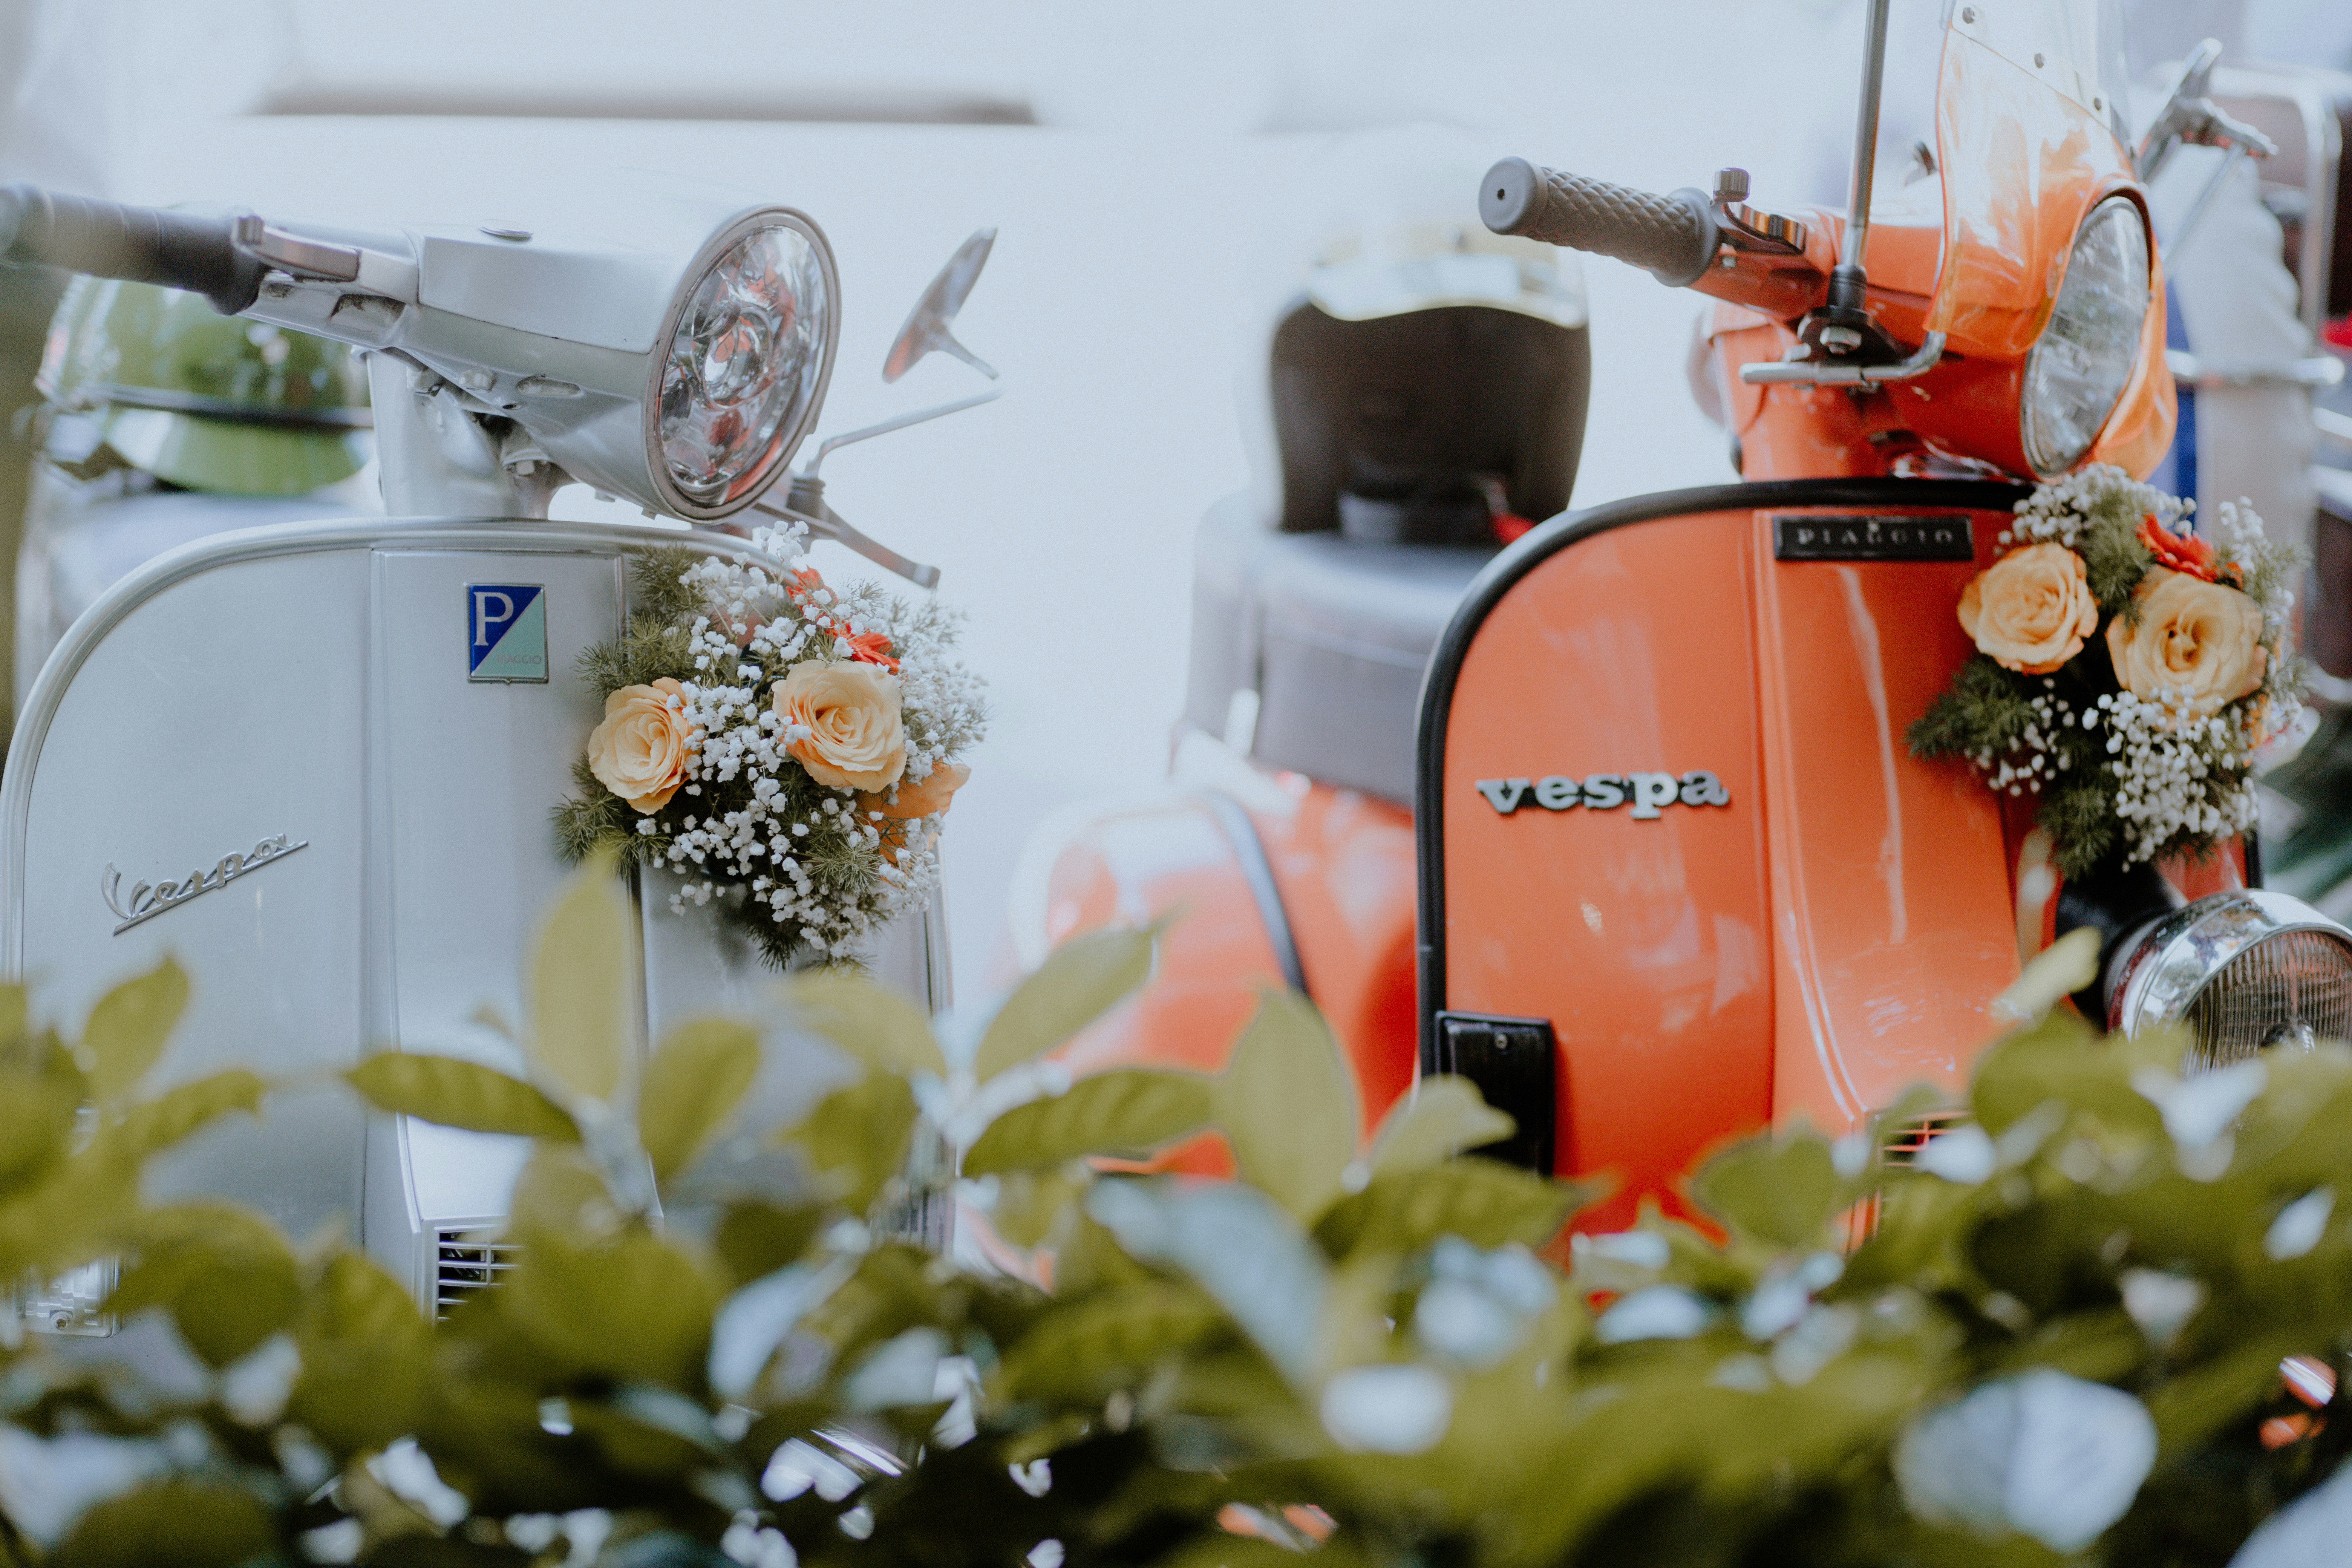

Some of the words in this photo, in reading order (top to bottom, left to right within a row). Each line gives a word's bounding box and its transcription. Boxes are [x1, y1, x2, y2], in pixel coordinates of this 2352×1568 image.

[1796, 528, 1954, 545] PIAGGIO
[473, 591, 514, 646] P
[1475, 770, 1730, 819] vespa
[101, 833, 308, 936] Vespa
